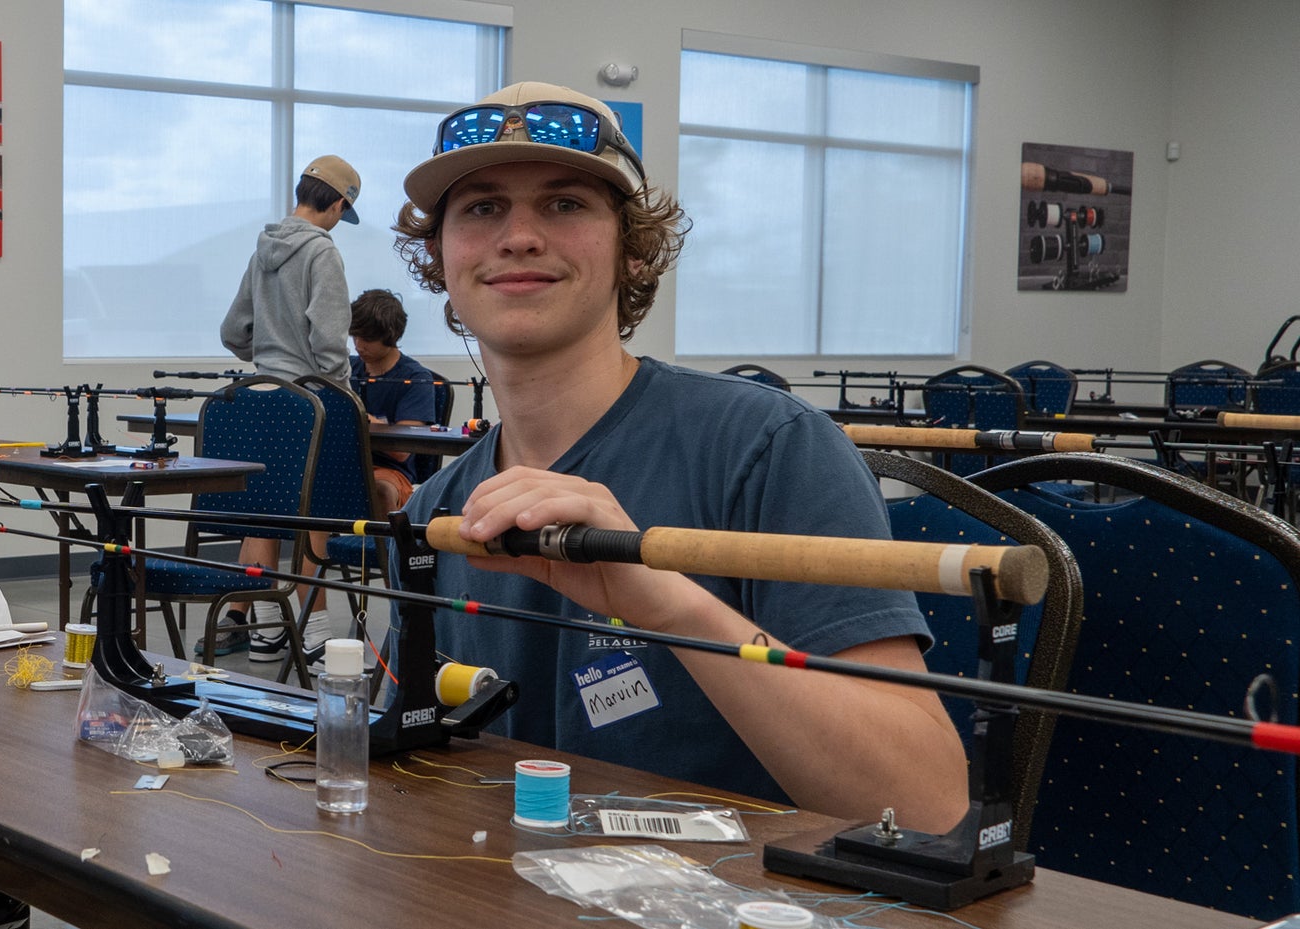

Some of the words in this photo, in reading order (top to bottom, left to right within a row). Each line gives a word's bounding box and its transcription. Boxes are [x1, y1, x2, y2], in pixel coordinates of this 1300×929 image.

[408, 555, 435, 566] CORE
[992, 623, 1018, 638] CORE
[574, 666, 603, 687] hello
[606, 667, 617, 675] my
[616, 660, 633, 672] name
[589, 680, 649, 715] Marvin
